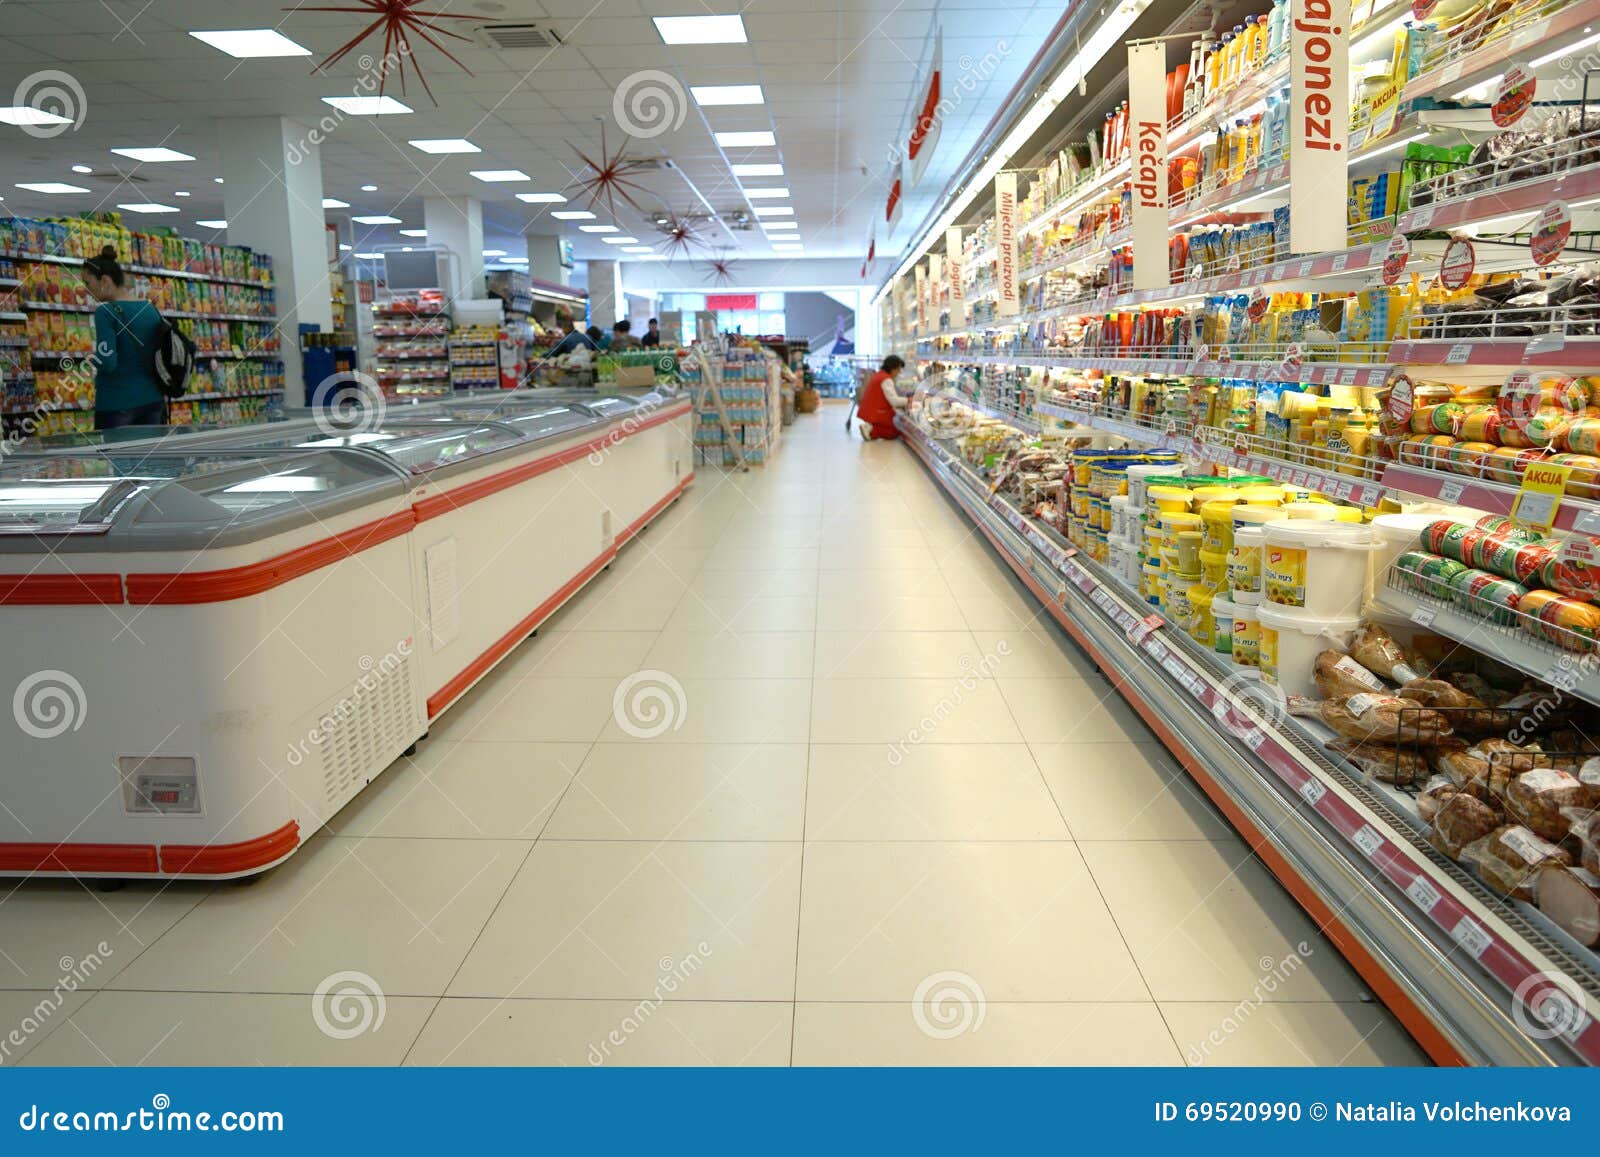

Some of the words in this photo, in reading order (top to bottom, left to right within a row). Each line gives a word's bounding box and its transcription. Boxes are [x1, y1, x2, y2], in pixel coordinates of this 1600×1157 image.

[1295, 0, 1342, 152] ajonezi
[1371, 85, 1398, 111] AKCIJA
[1134, 122, 1164, 208] Kečapi
[951, 261, 963, 299] Jogurti
[1000, 242, 1014, 301] proizvodi
[1525, 469, 1563, 486] AKCIJA
